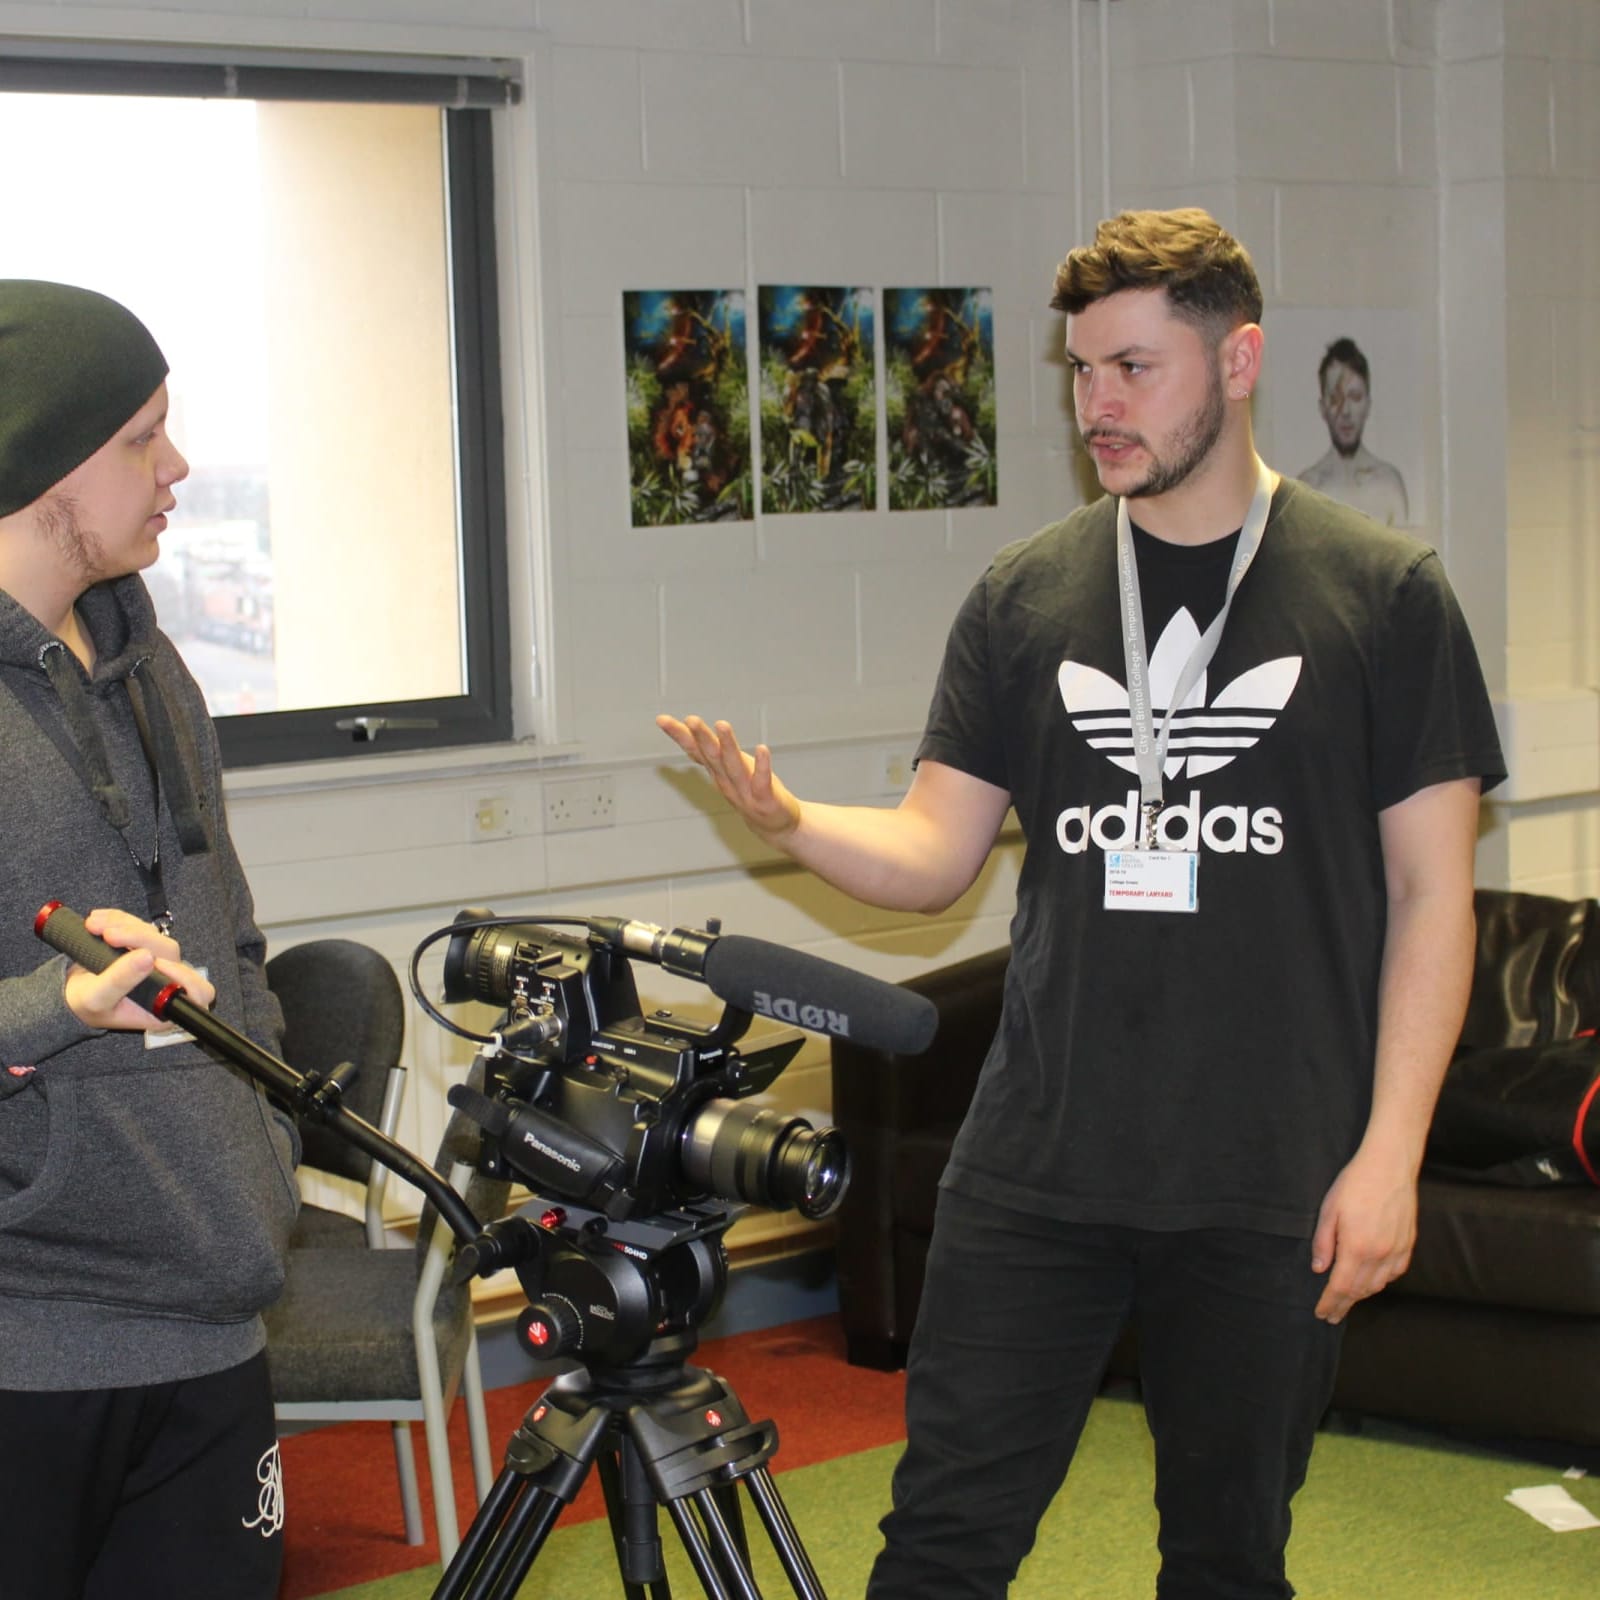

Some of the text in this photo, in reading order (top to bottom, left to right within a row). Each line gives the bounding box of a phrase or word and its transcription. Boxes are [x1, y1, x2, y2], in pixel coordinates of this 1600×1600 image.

[1127, 592, 1138, 643] Temporary
[1130, 649, 1143, 687] College
[1133, 688, 1145, 720] Bristol
[1109, 889, 1145, 897] TEMPORARY
[524, 1131, 581, 1172] Panasonic
